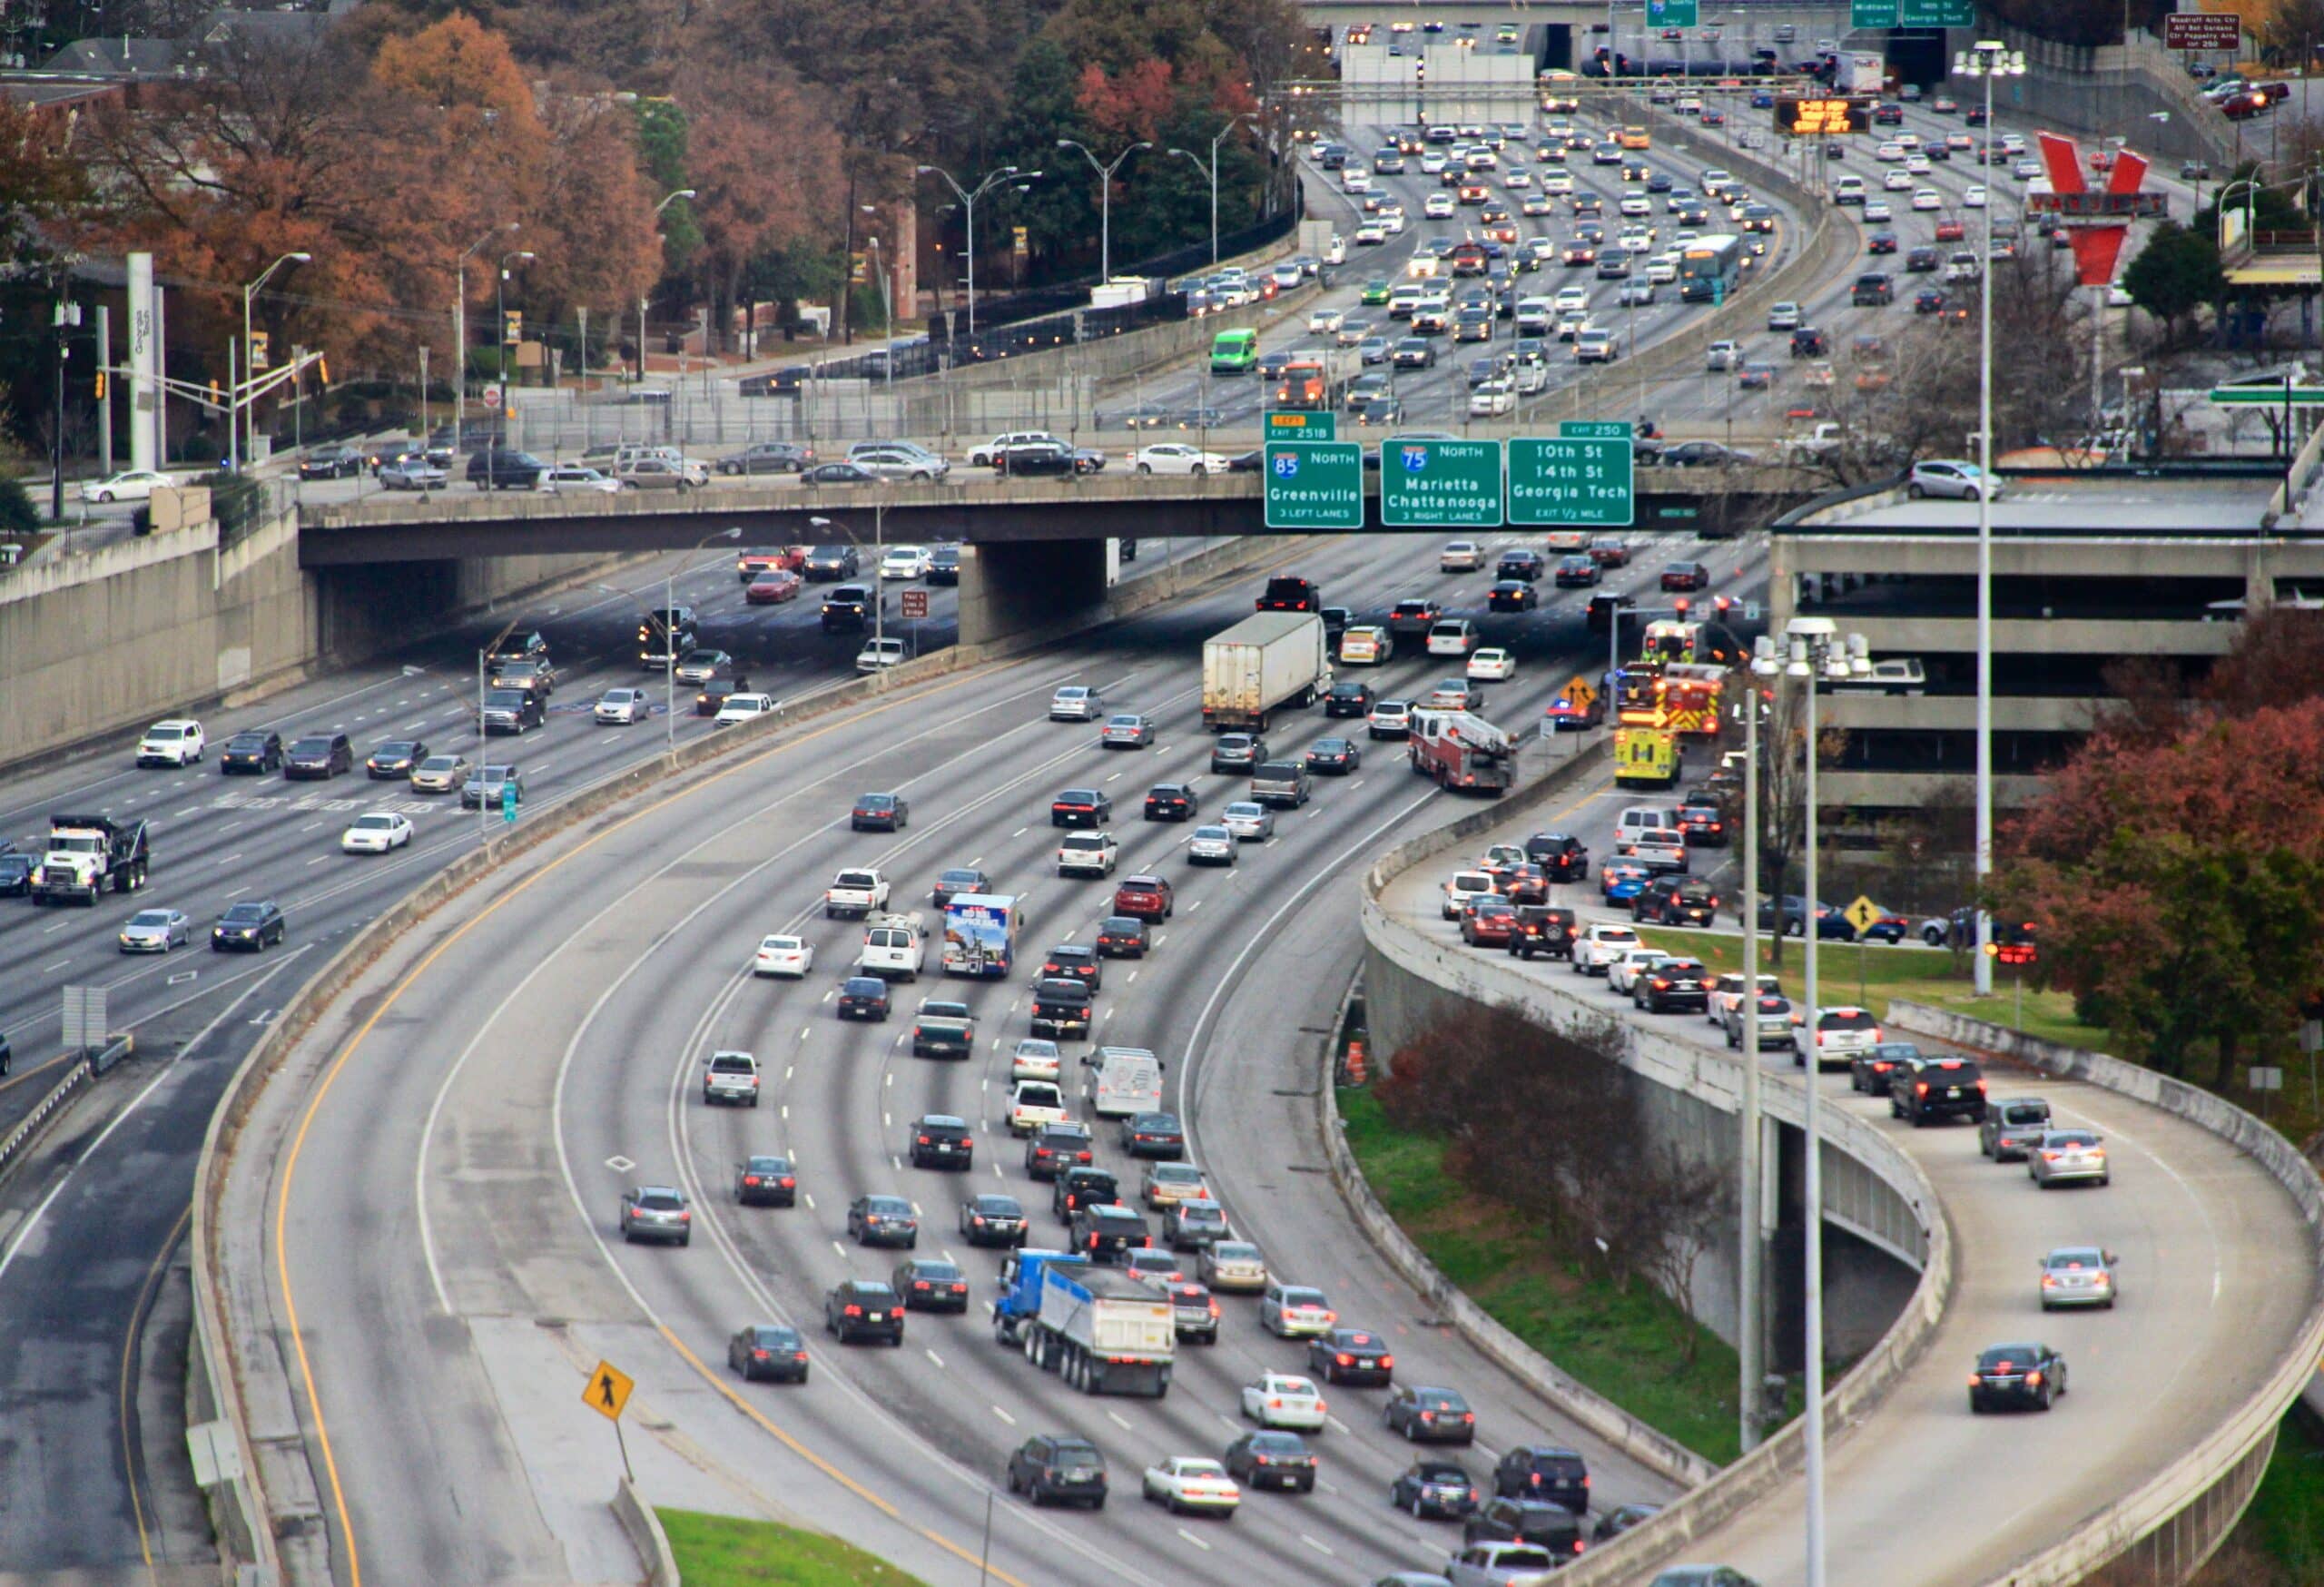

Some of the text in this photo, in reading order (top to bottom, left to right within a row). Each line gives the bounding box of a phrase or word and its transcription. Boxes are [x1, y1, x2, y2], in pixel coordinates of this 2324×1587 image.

[1271, 428, 1327, 438] EXIT 251B
[1571, 425, 1620, 435] EXIT 250
[1537, 445, 1602, 458] 10th St
[1275, 458, 1297, 474] 85
[1404, 452, 1426, 468] 75
[1536, 465, 1603, 478] 14th St
[1405, 478, 1479, 490] Marietta
[1271, 488, 1358, 501] Greenville
[1513, 484, 1627, 501] Georgia Tech
[1388, 496, 1497, 511] Chattanooga
[1280, 508, 1350, 518] 3 LEFT LANES
[1403, 512, 1409, 520] 3
[1449, 512, 1482, 520] LANES
[1536, 508, 1558, 518] EXIT
[1581, 509, 1603, 518] MILE
